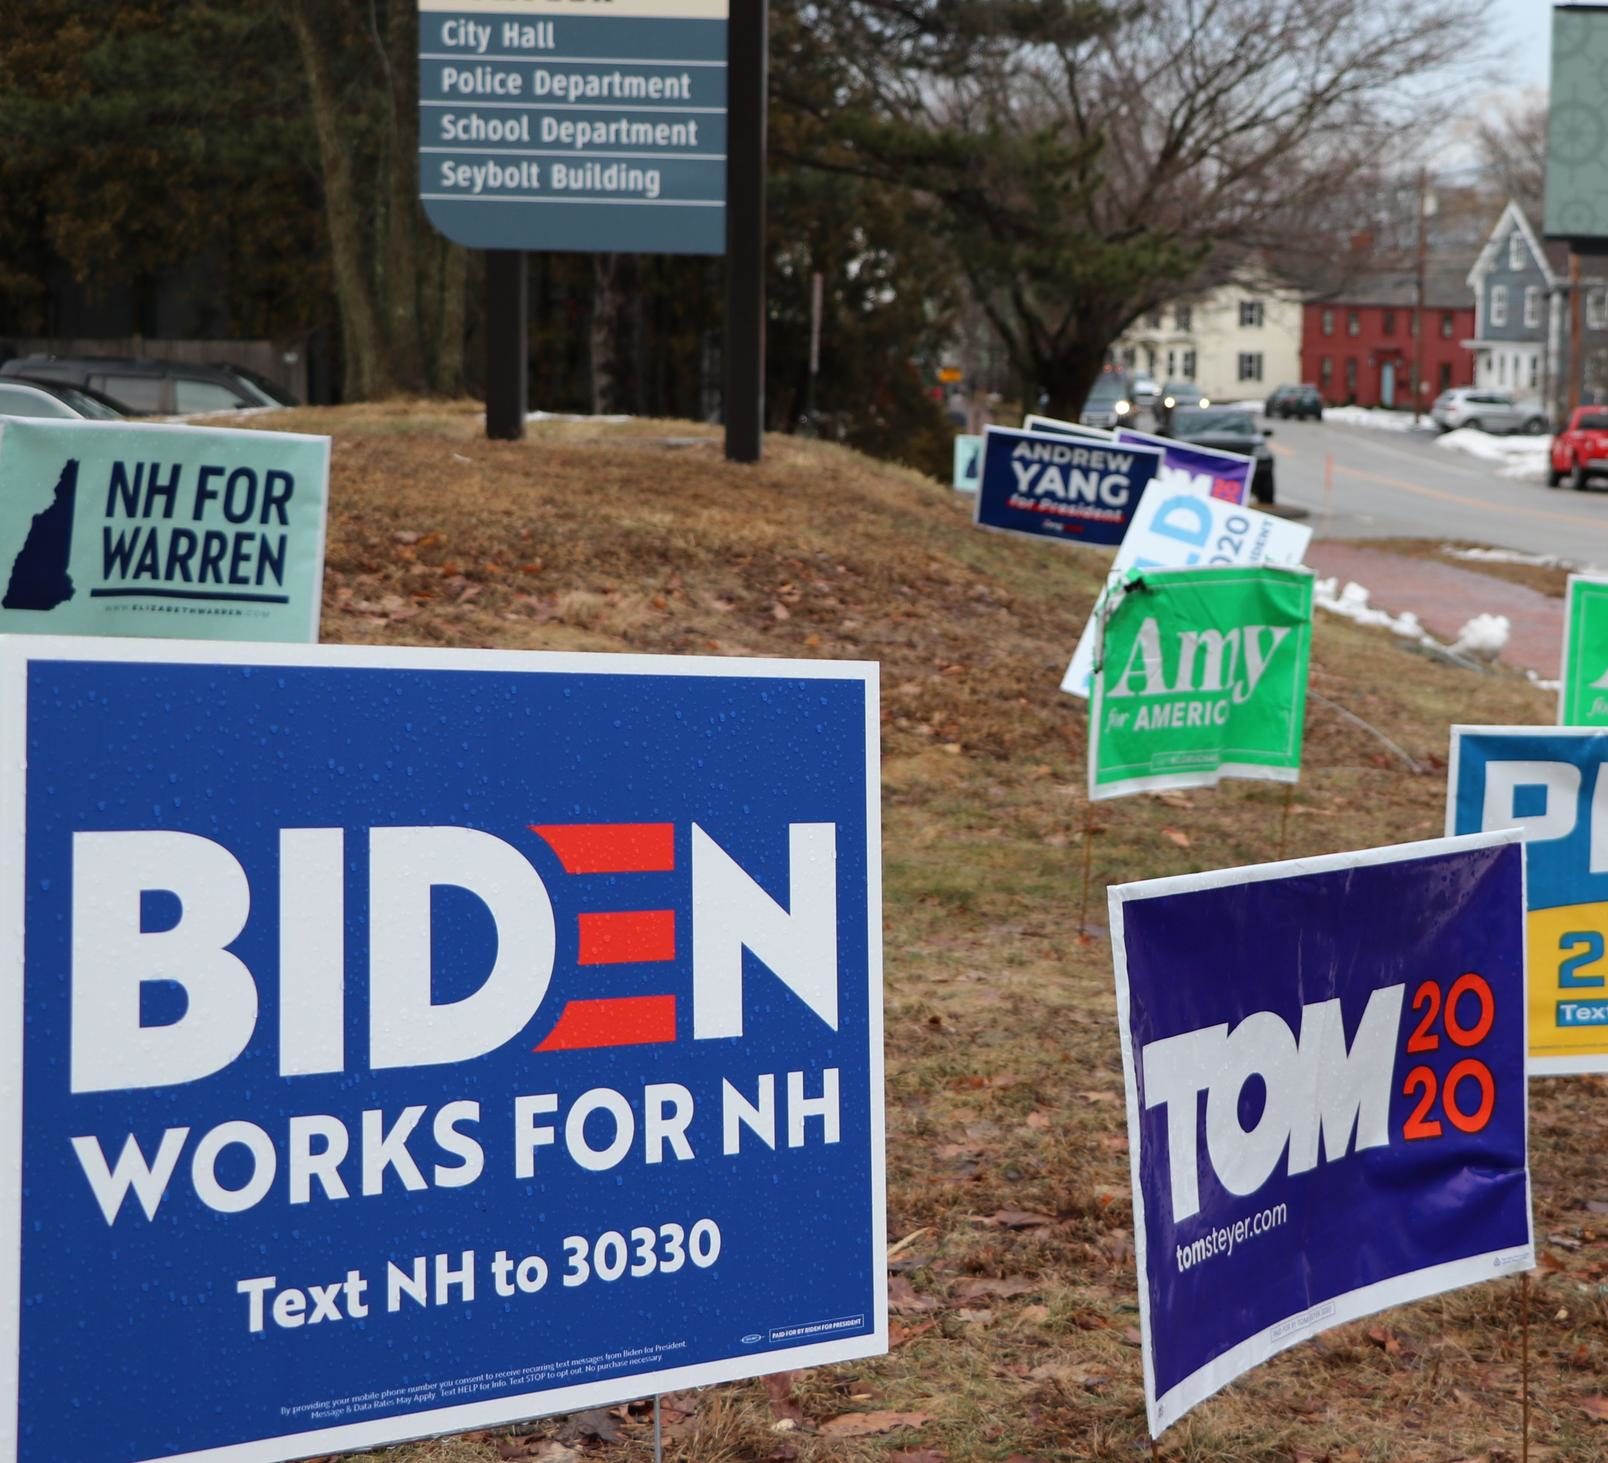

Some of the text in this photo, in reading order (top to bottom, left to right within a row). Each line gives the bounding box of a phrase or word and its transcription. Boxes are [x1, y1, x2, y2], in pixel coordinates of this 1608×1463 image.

[441, 19, 555, 53] City Hall
[441, 67, 691, 102] Police Department
[441, 113, 698, 149] School Department
[441, 160, 660, 199] Seybolt Building
[1011, 460, 1130, 507] YANG
[1012, 441, 1134, 473] ANDREW
[105, 461, 294, 526] NH FOR
[1038, 498, 1123, 523] President
[103, 526, 288, 587] WARREN
[1106, 617, 1292, 705] Amy
[1105, 707, 1130, 734] for
[71, 822, 838, 1094] BIDEN
[1407, 972, 1495, 1053] 20
[1142, 983, 1405, 1223] TOM
[1402, 1058, 1495, 1140] 20
[71, 1067, 840, 1227] WORKS FOR NH
[1176, 1202, 1287, 1273] tomsteyer.com
[237, 1218, 722, 1333] Text NH to 30330
[832, 1318, 862, 1329] PRESIDENT
[292, 1399, 331, 1414] providing
[332, 1397, 350, 1408] your
[352, 1391, 380, 1403] mobile
[381, 1387, 406, 1400] phone
[408, 1383, 437, 1394] number
[455, 1373, 484, 1386] consent
[495, 1368, 521, 1379] receive
[522, 1362, 555, 1374] recurring
[556, 1359, 570, 1369] text
[571, 1355, 603, 1366] messages
[605, 1351, 622, 1361] from
[623, 1348, 643, 1359] Biden
[311, 1405, 344, 1419] Message
[353, 1402, 372, 1412] Data
[374, 1398, 395, 1408] Rates
[442, 1387, 456, 1397] Text
[458, 1383, 478, 1394] HELP
[510, 1376, 525, 1386] Text
[526, 1371, 546, 1383] STOP
[597, 1359, 629, 1372] purchase
